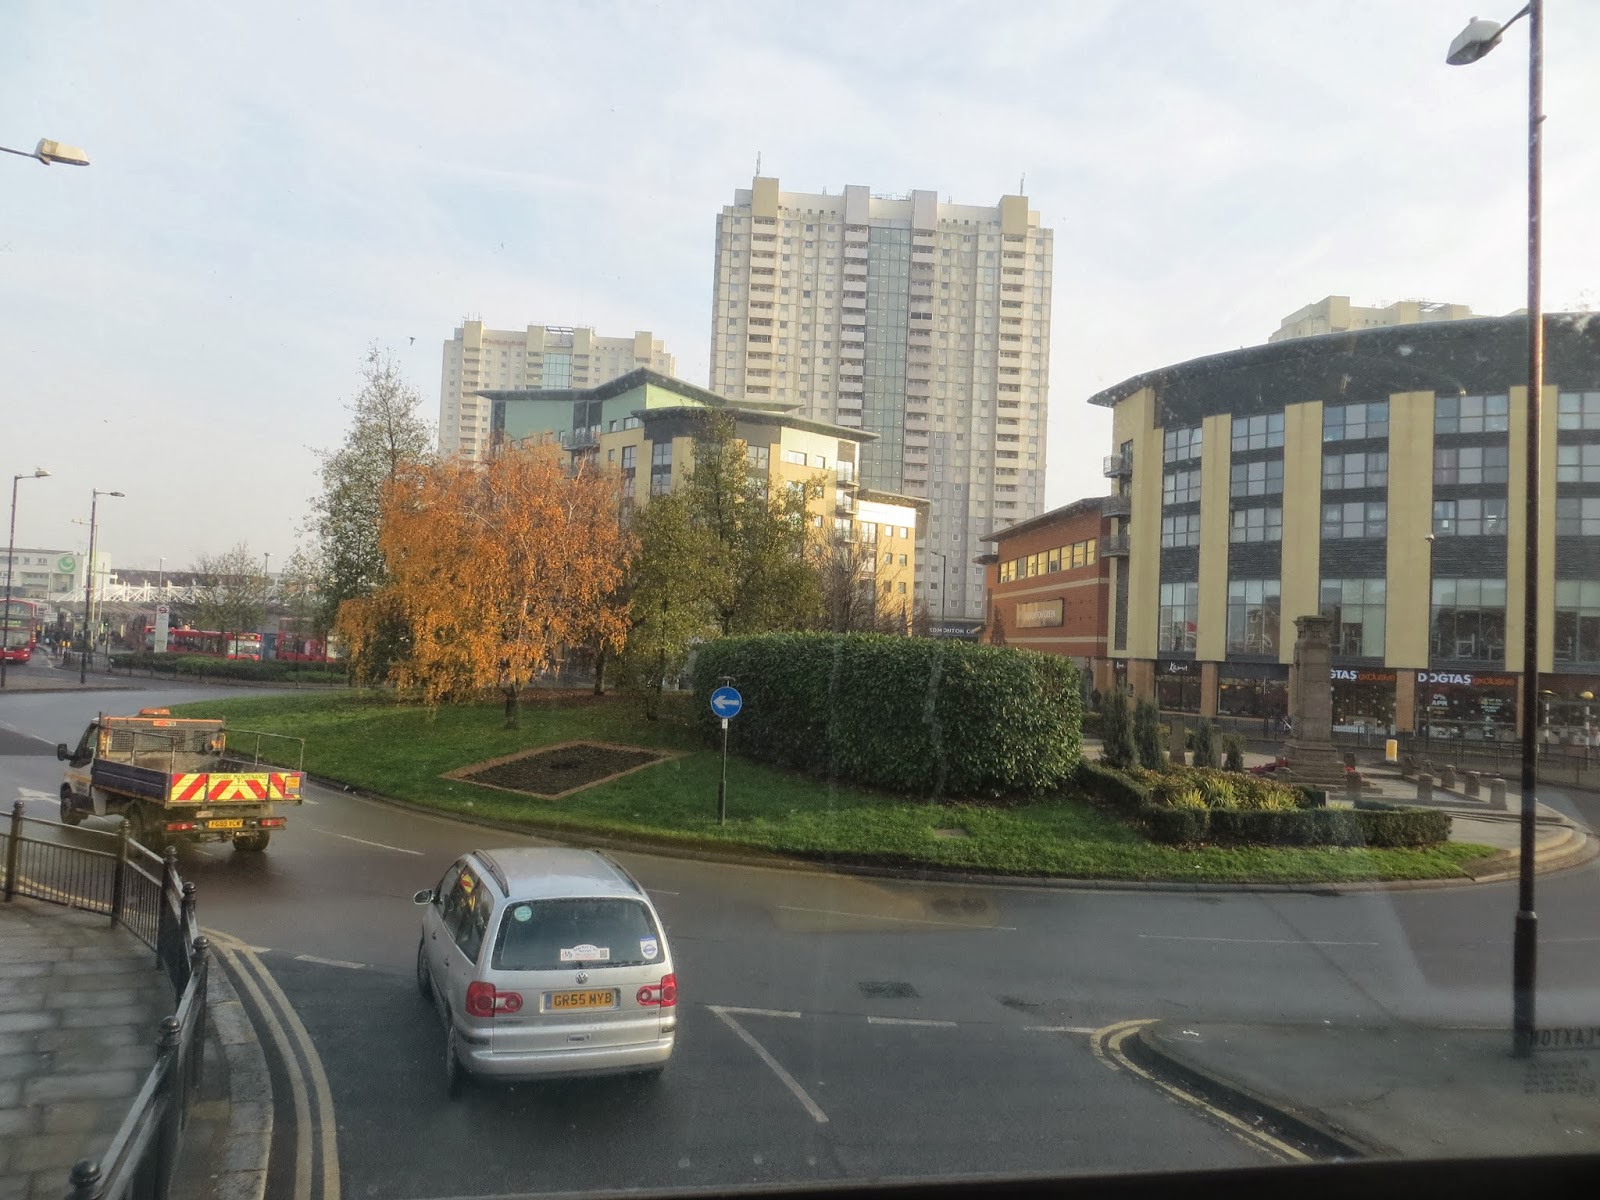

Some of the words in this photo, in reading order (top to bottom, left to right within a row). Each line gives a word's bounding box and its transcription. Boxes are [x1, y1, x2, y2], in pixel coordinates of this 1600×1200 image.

[1358, 672, 1396, 681] exclusive
[1472, 676, 1515, 686] exclusive
[554, 993, 586, 1006] GR55
[589, 991, 612, 1005] MYB
